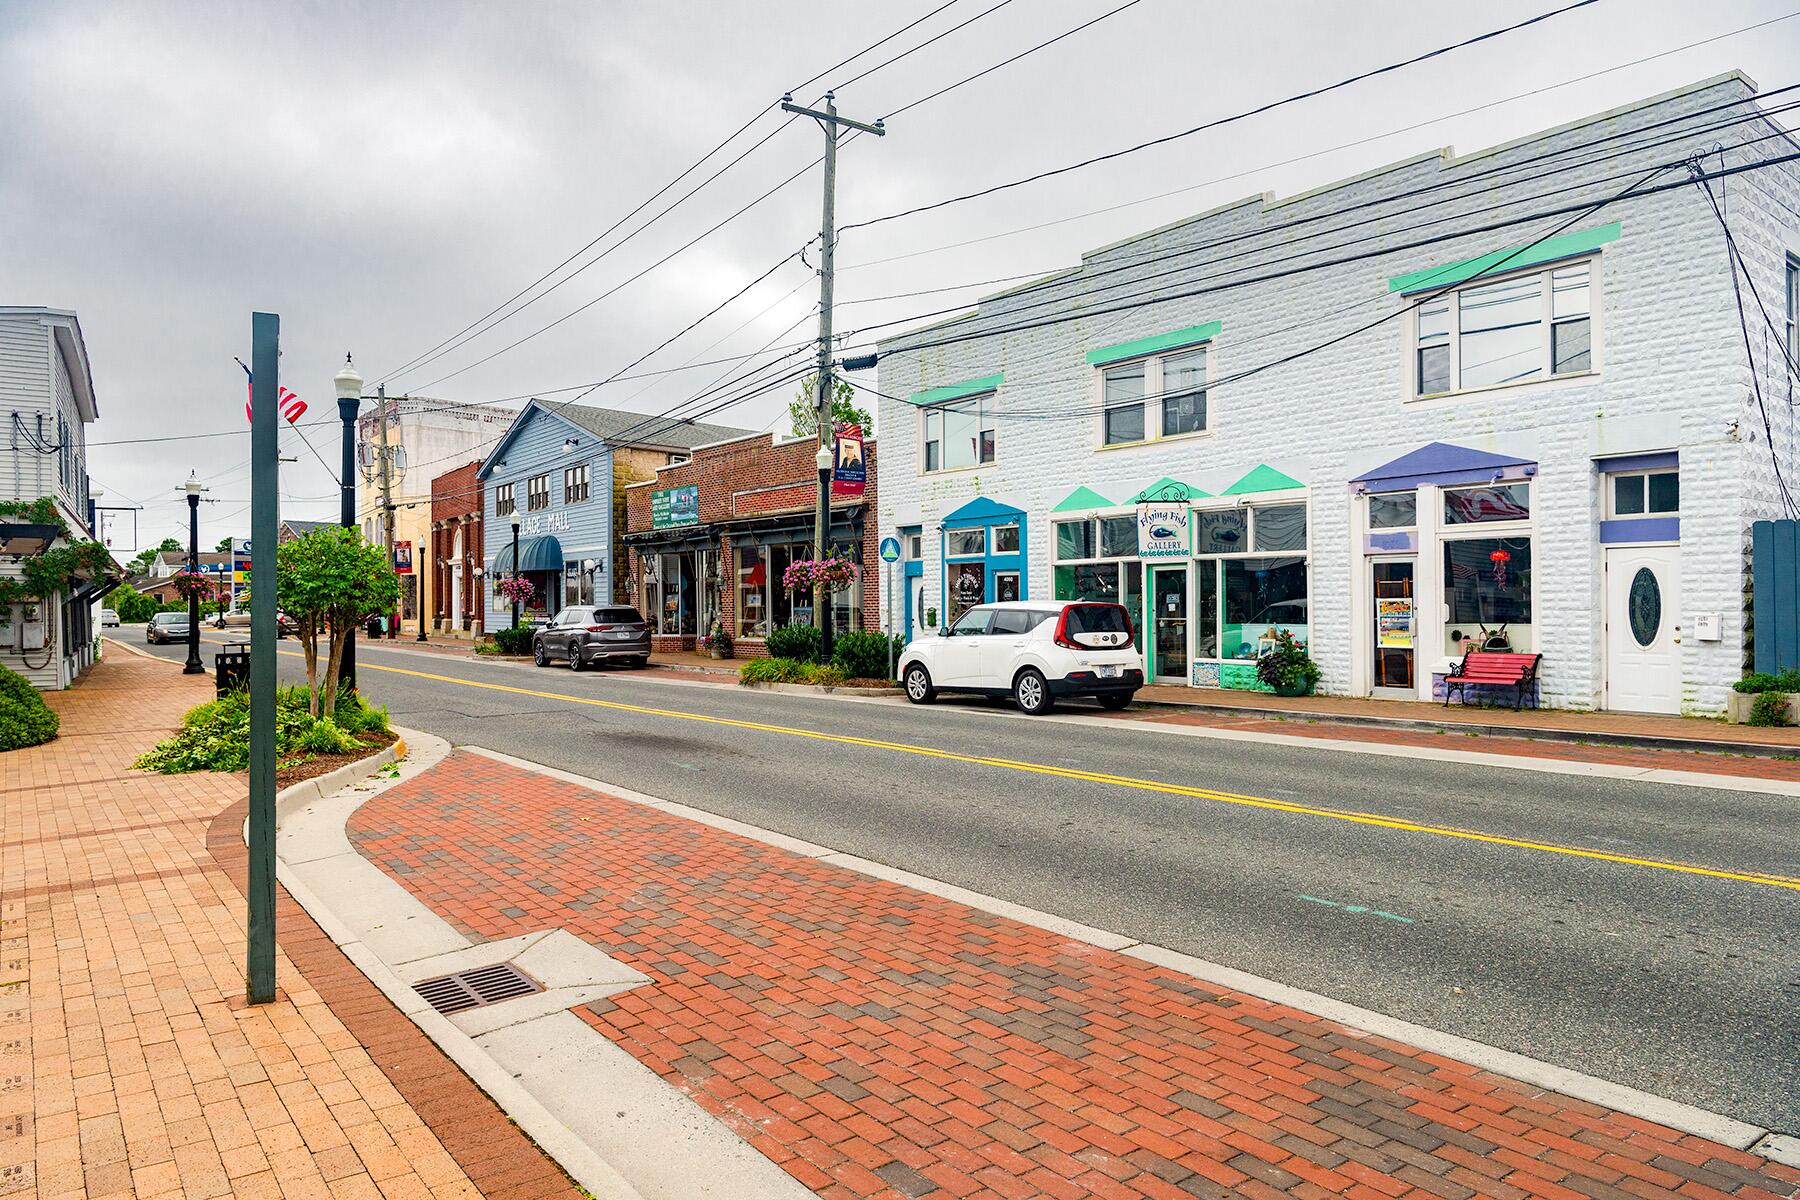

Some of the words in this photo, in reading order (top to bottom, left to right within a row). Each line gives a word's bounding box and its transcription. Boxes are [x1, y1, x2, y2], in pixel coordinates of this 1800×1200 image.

[547, 511, 570, 532] MALL
[1140, 510, 1168, 527] Flying
[1170, 511, 1187, 528] Fish
[1147, 541, 1182, 550] GALLERY
